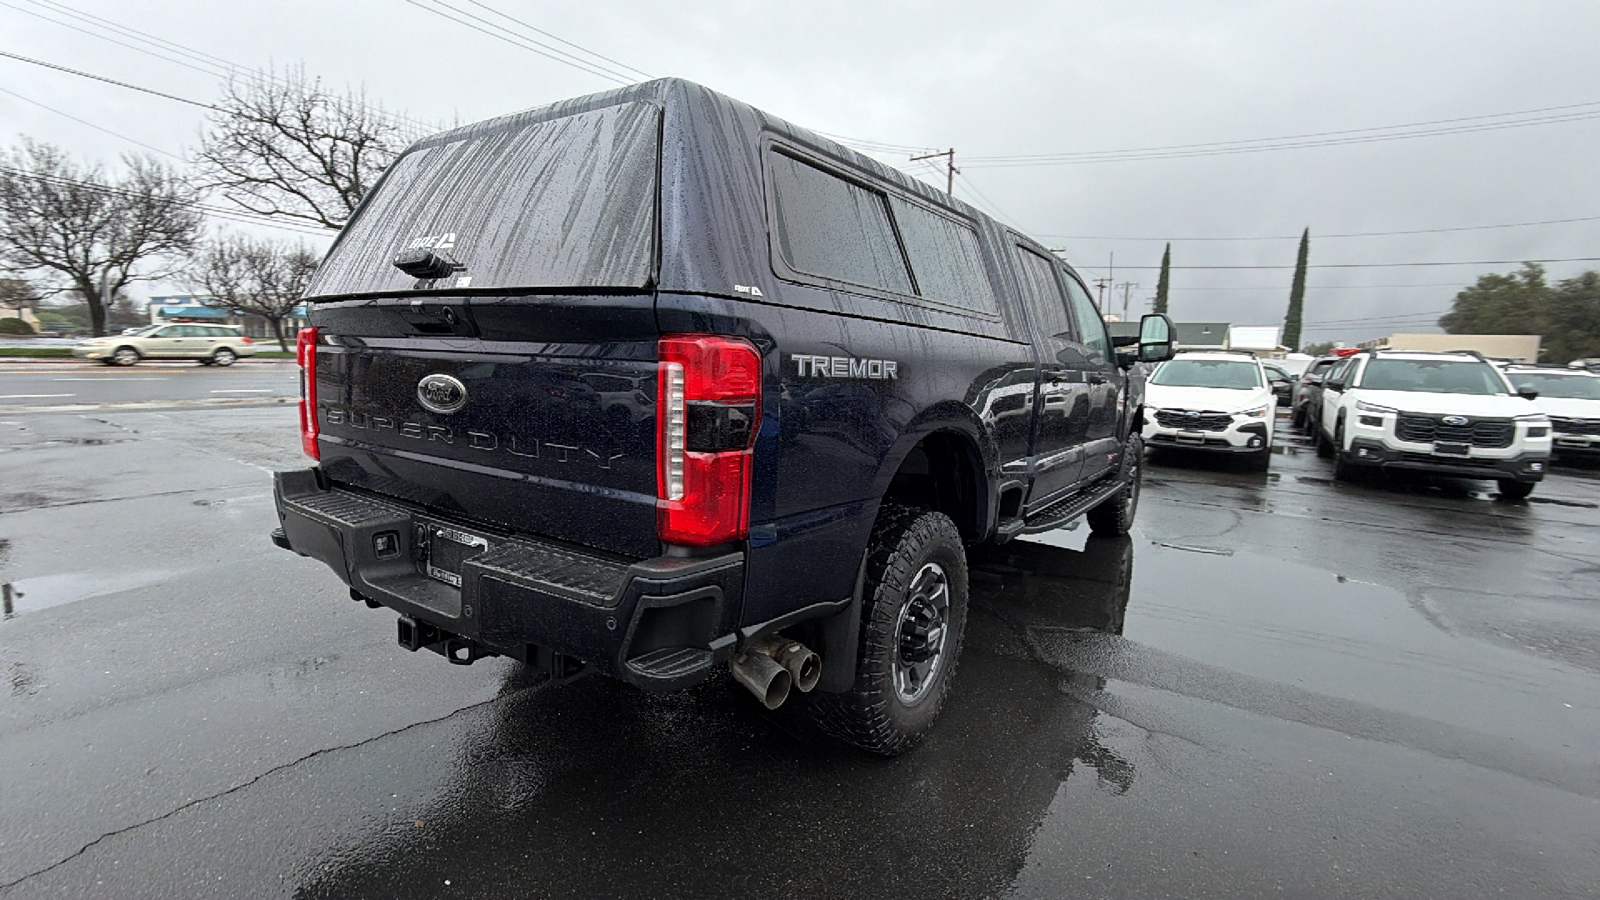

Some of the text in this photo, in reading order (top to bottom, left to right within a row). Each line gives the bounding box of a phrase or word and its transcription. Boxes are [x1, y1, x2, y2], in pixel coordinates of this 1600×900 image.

[791, 353, 898, 379] TREMOR
[426, 381, 453, 401] Ford
[327, 408, 624, 470] SUPER DUTY
